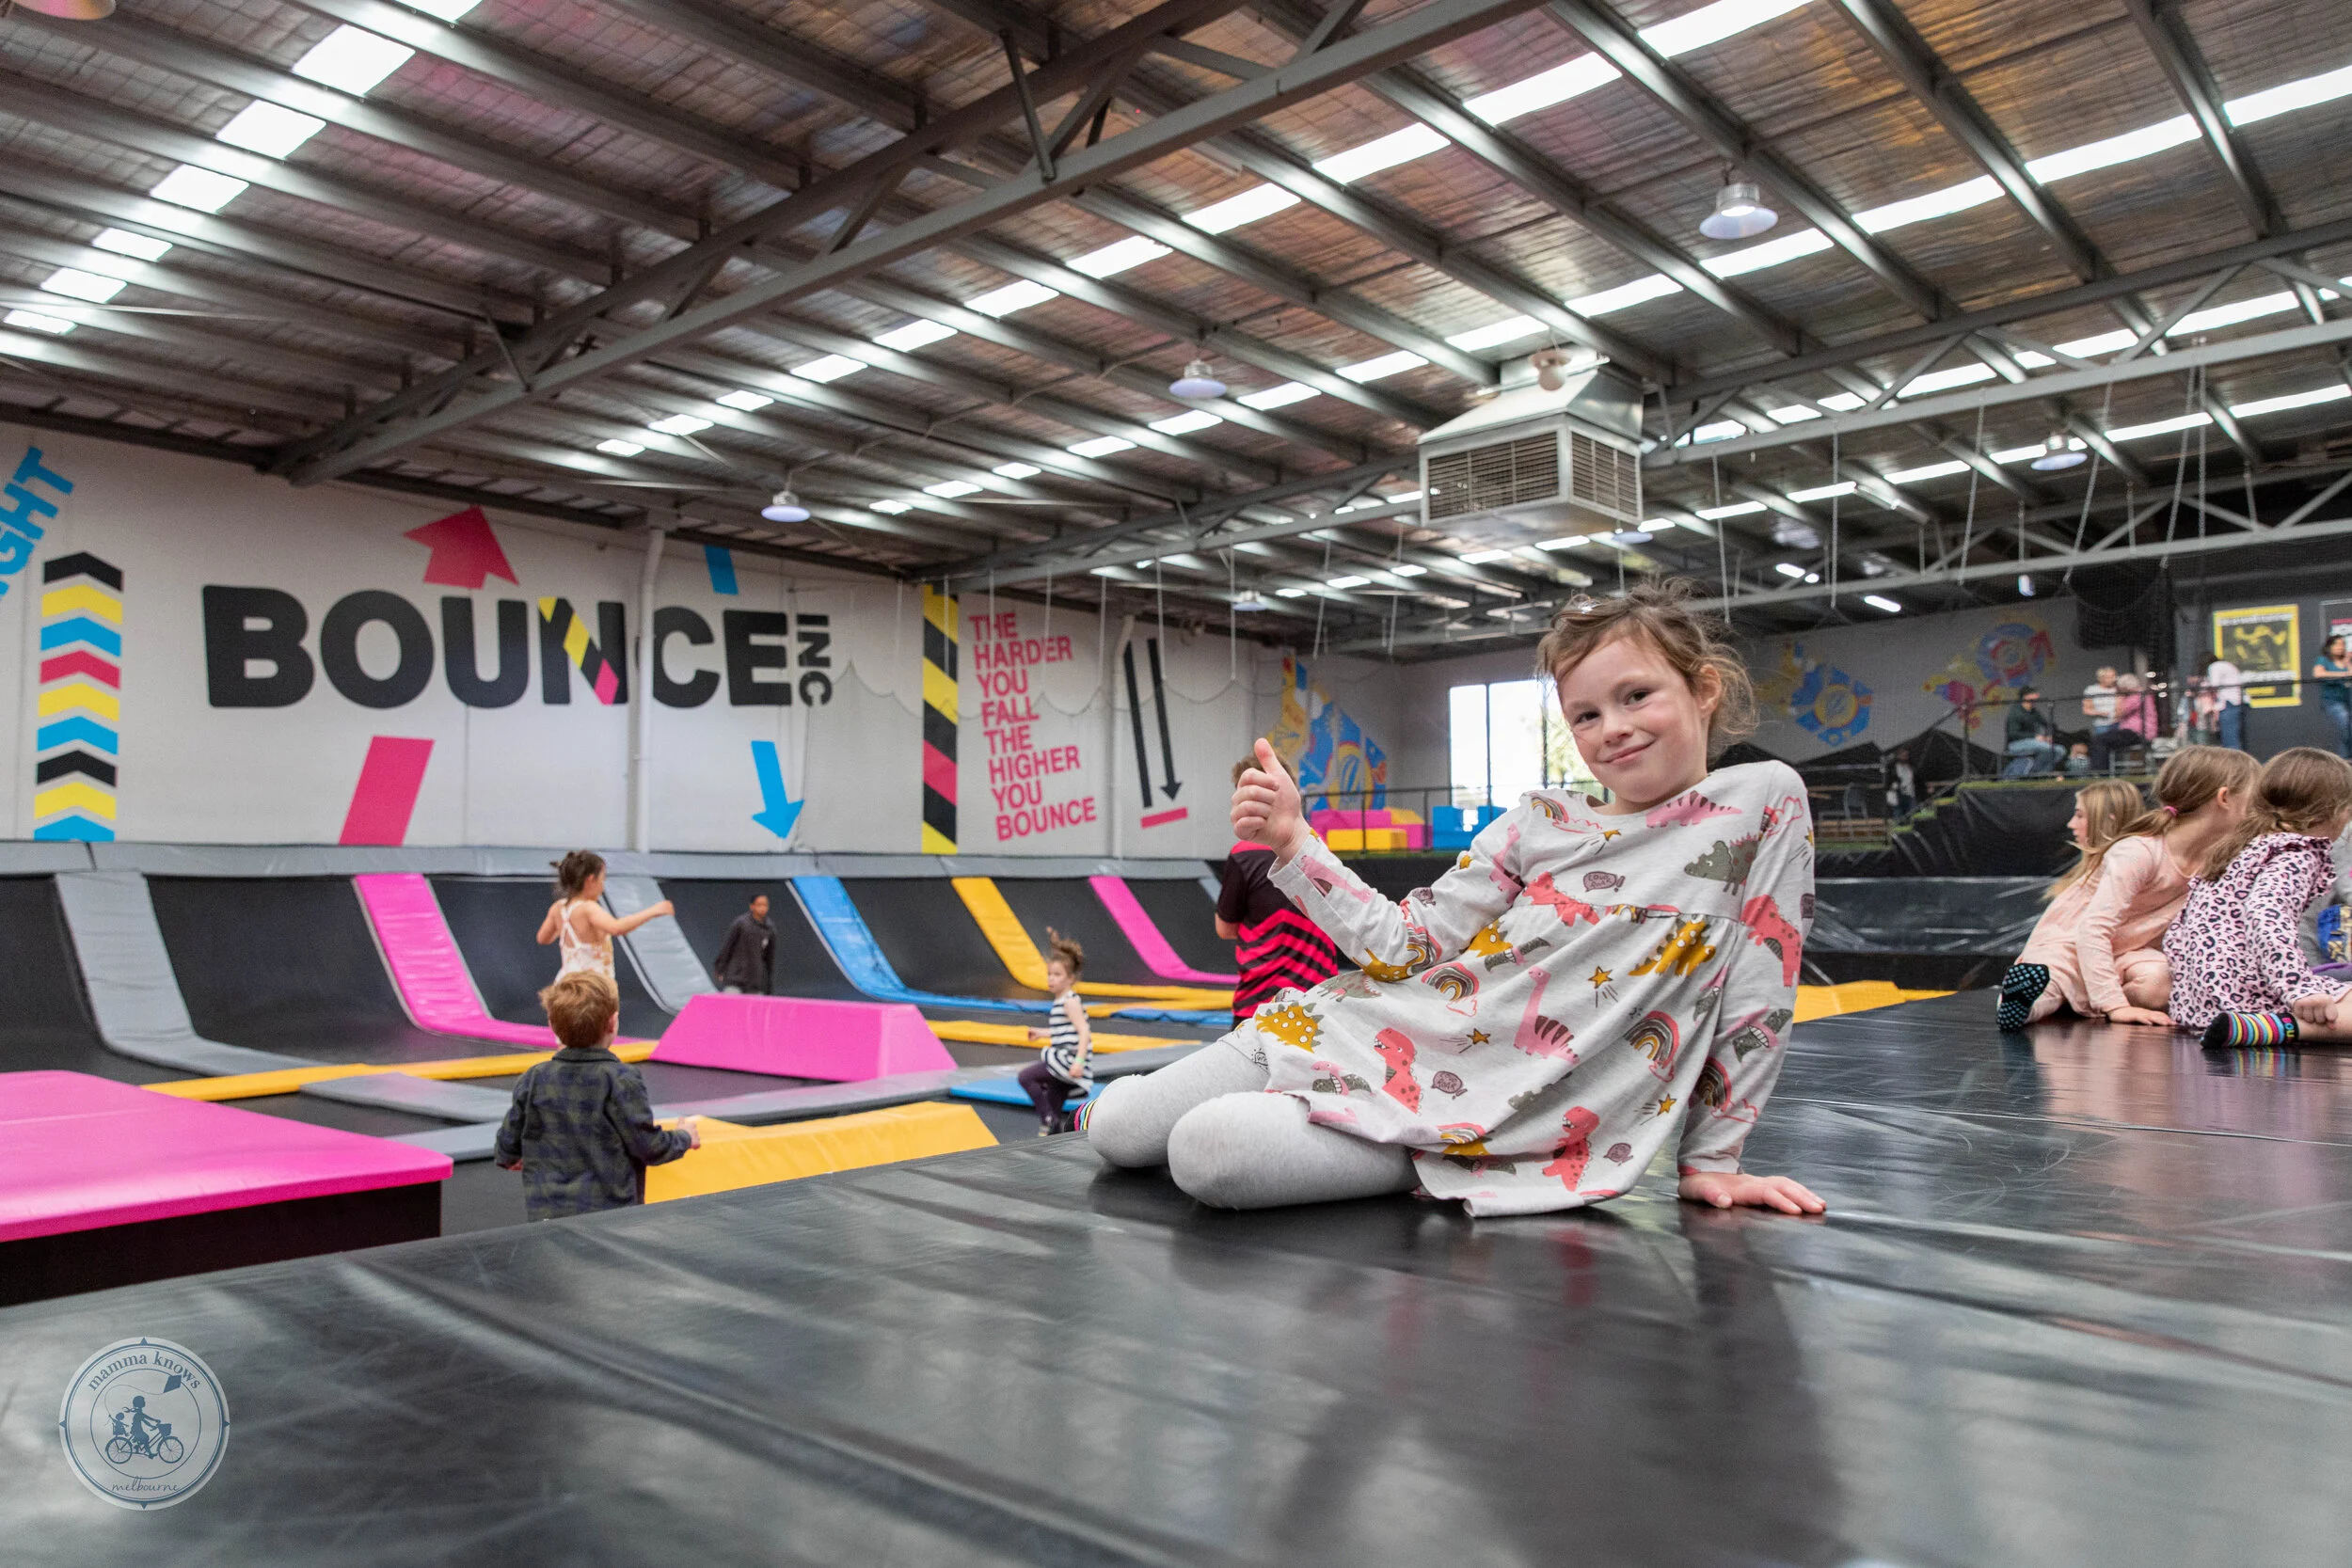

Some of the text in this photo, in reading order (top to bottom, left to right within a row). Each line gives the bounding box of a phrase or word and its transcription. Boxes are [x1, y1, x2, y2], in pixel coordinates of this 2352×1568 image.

[0, 446, 74, 603] GHT
[968, 612, 1018, 641] THE
[201, 584, 833, 708] BOUNCE INC
[973, 635, 1073, 671] HARDER
[977, 669, 1028, 698] YOU
[980, 696, 1040, 727] FALL
[983, 725, 1033, 755] THE
[989, 745, 1080, 784] HIGHER
[992, 780, 1042, 812] YOU
[995, 798, 1097, 842] BOUNCE
